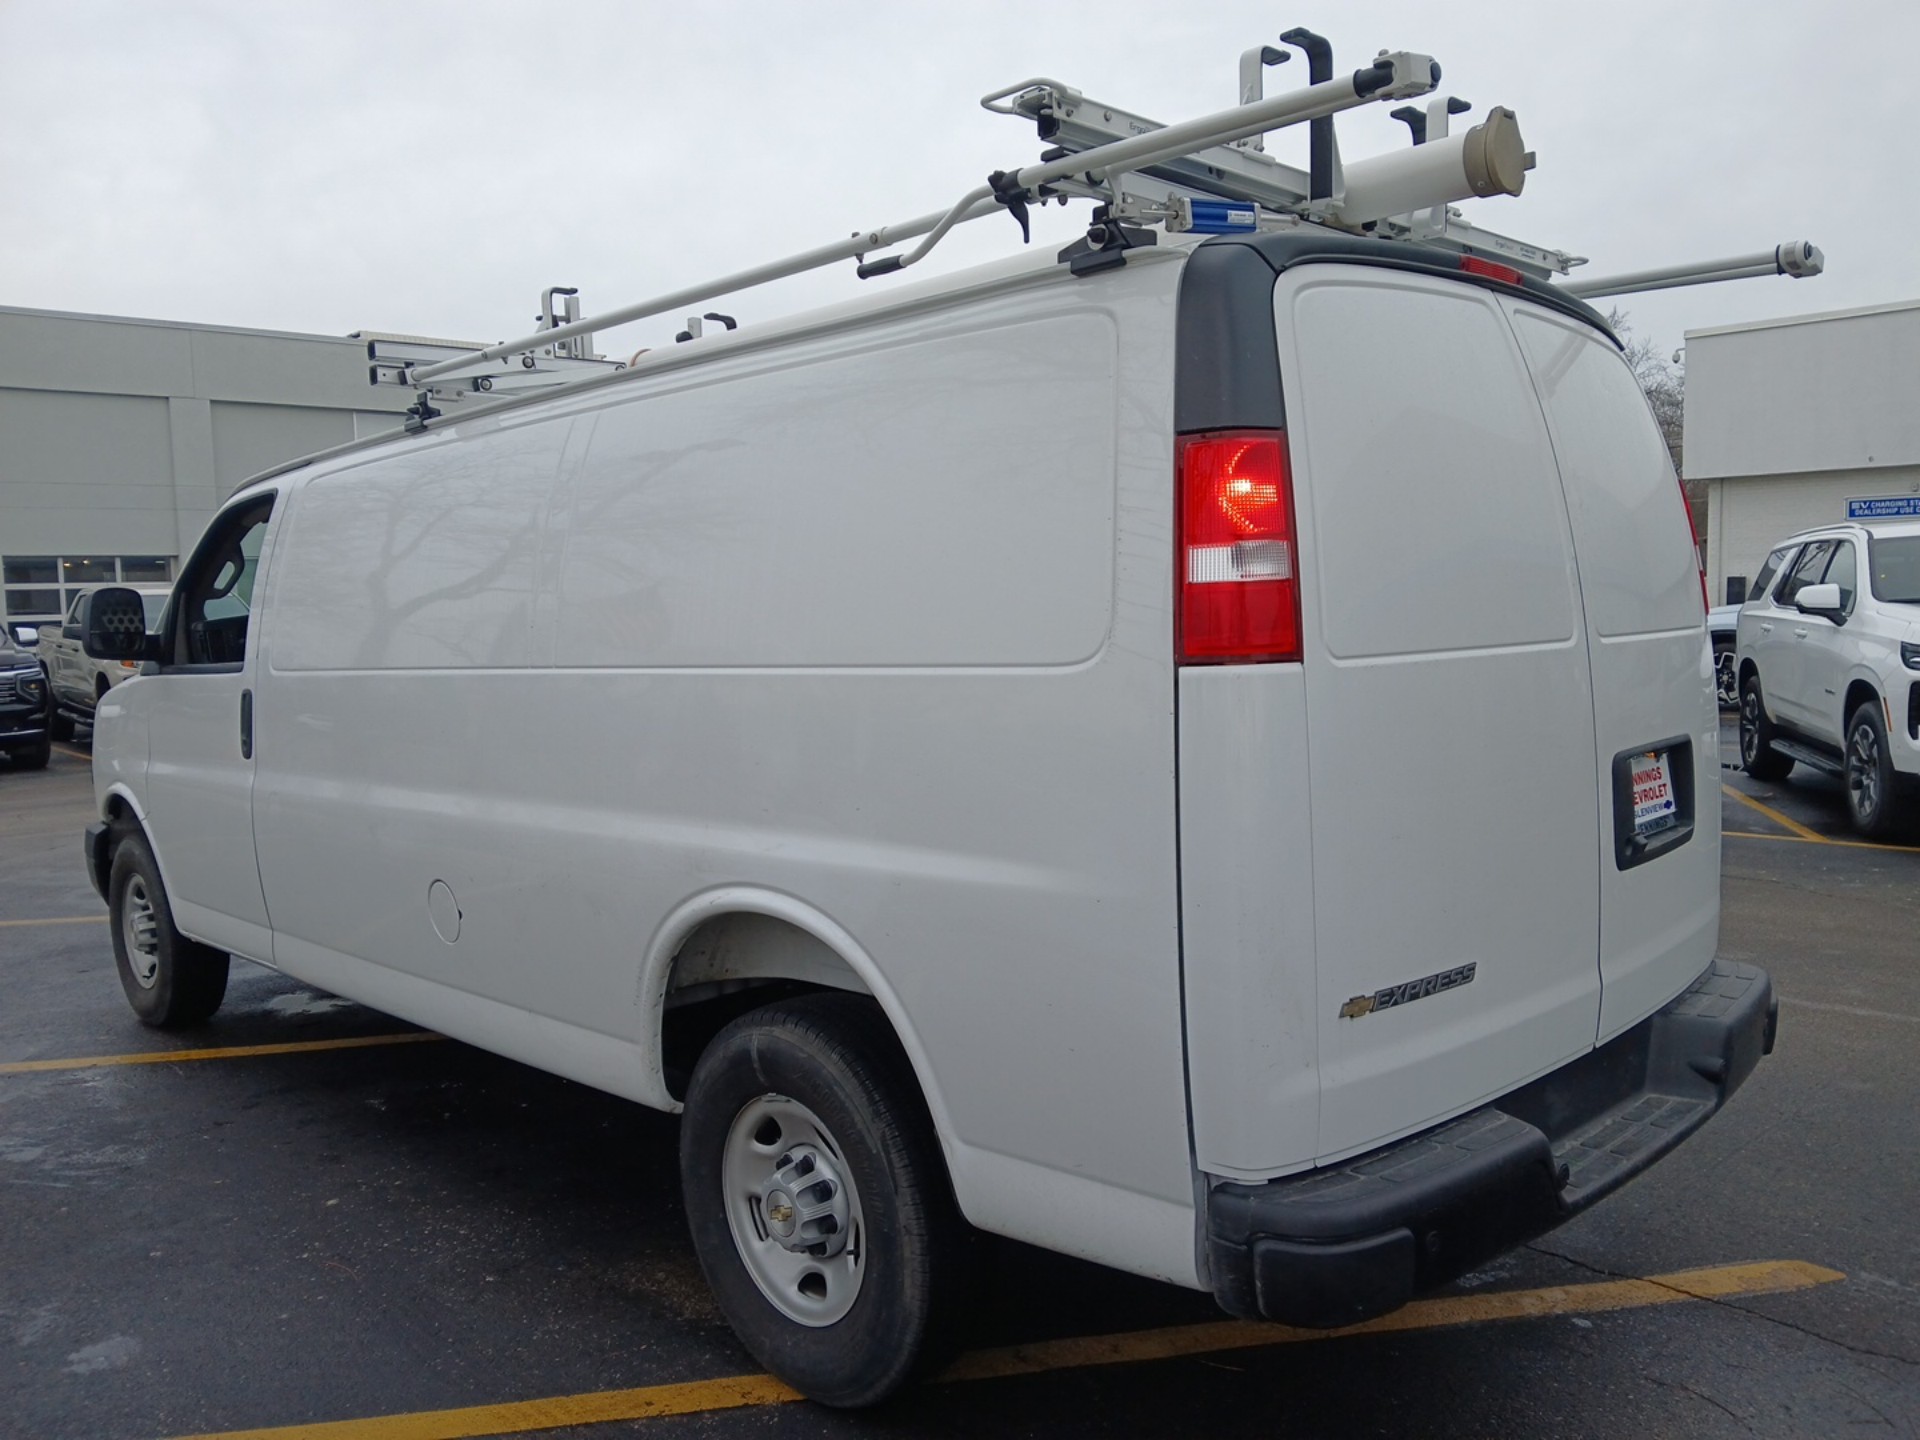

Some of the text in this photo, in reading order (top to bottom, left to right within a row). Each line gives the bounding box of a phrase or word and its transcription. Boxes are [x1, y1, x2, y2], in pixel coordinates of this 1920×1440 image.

[1870, 500, 1908, 508] CHARGING
[1855, 507, 1898, 515] DEALERSHIP
[1374, 962, 1477, 1012] EXPRESS
